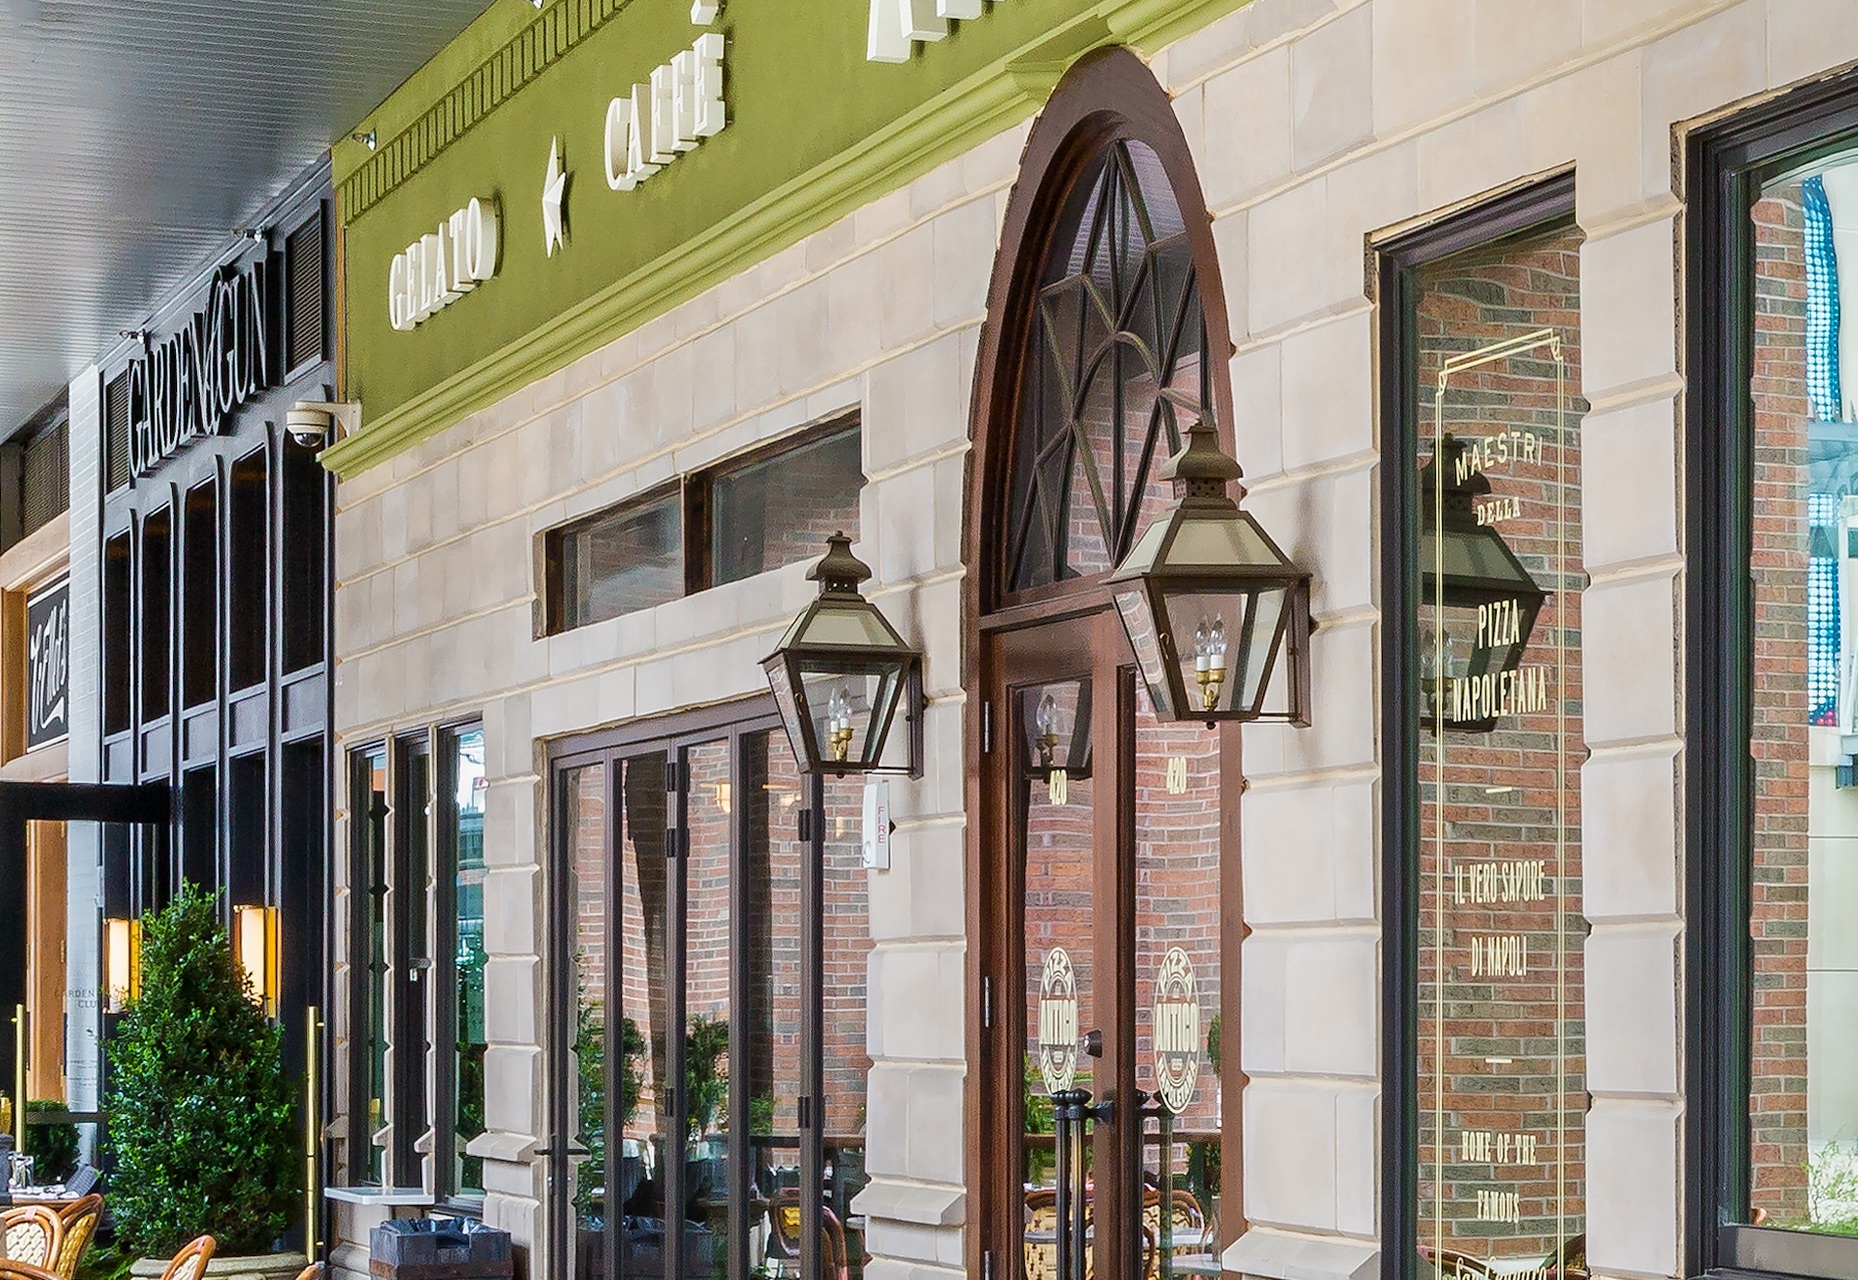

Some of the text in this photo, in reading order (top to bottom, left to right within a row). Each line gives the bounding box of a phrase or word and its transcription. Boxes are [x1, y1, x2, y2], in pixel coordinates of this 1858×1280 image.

[389, 196, 497, 331] GELATO
[128, 313, 207, 479] GARDEN
[217, 262, 268, 414] GUN
[1454, 431, 1543, 486] MAESTRI
[1476, 497, 1521, 526] DELLA
[1477, 599, 1520, 649] PIZZA
[1452, 666, 1547, 722] NAPOLETANA
[1049, 769, 1067, 805] 420
[1167, 755, 1187, 795] 420
[877, 805, 886, 844] FIRE
[1454, 860, 1545, 904] IL VERO SAPORE
[1159, 951, 1192, 1002] PIZZA
[1471, 936, 1527, 977] DI NAPOLI
[1040, 1000, 1077, 1046] ANTICO
[1156, 1002, 1199, 1052] ANTICO
[1461, 1131, 1536, 1165] HOME OF THE
[1477, 1190, 1520, 1224] FAMOUS
